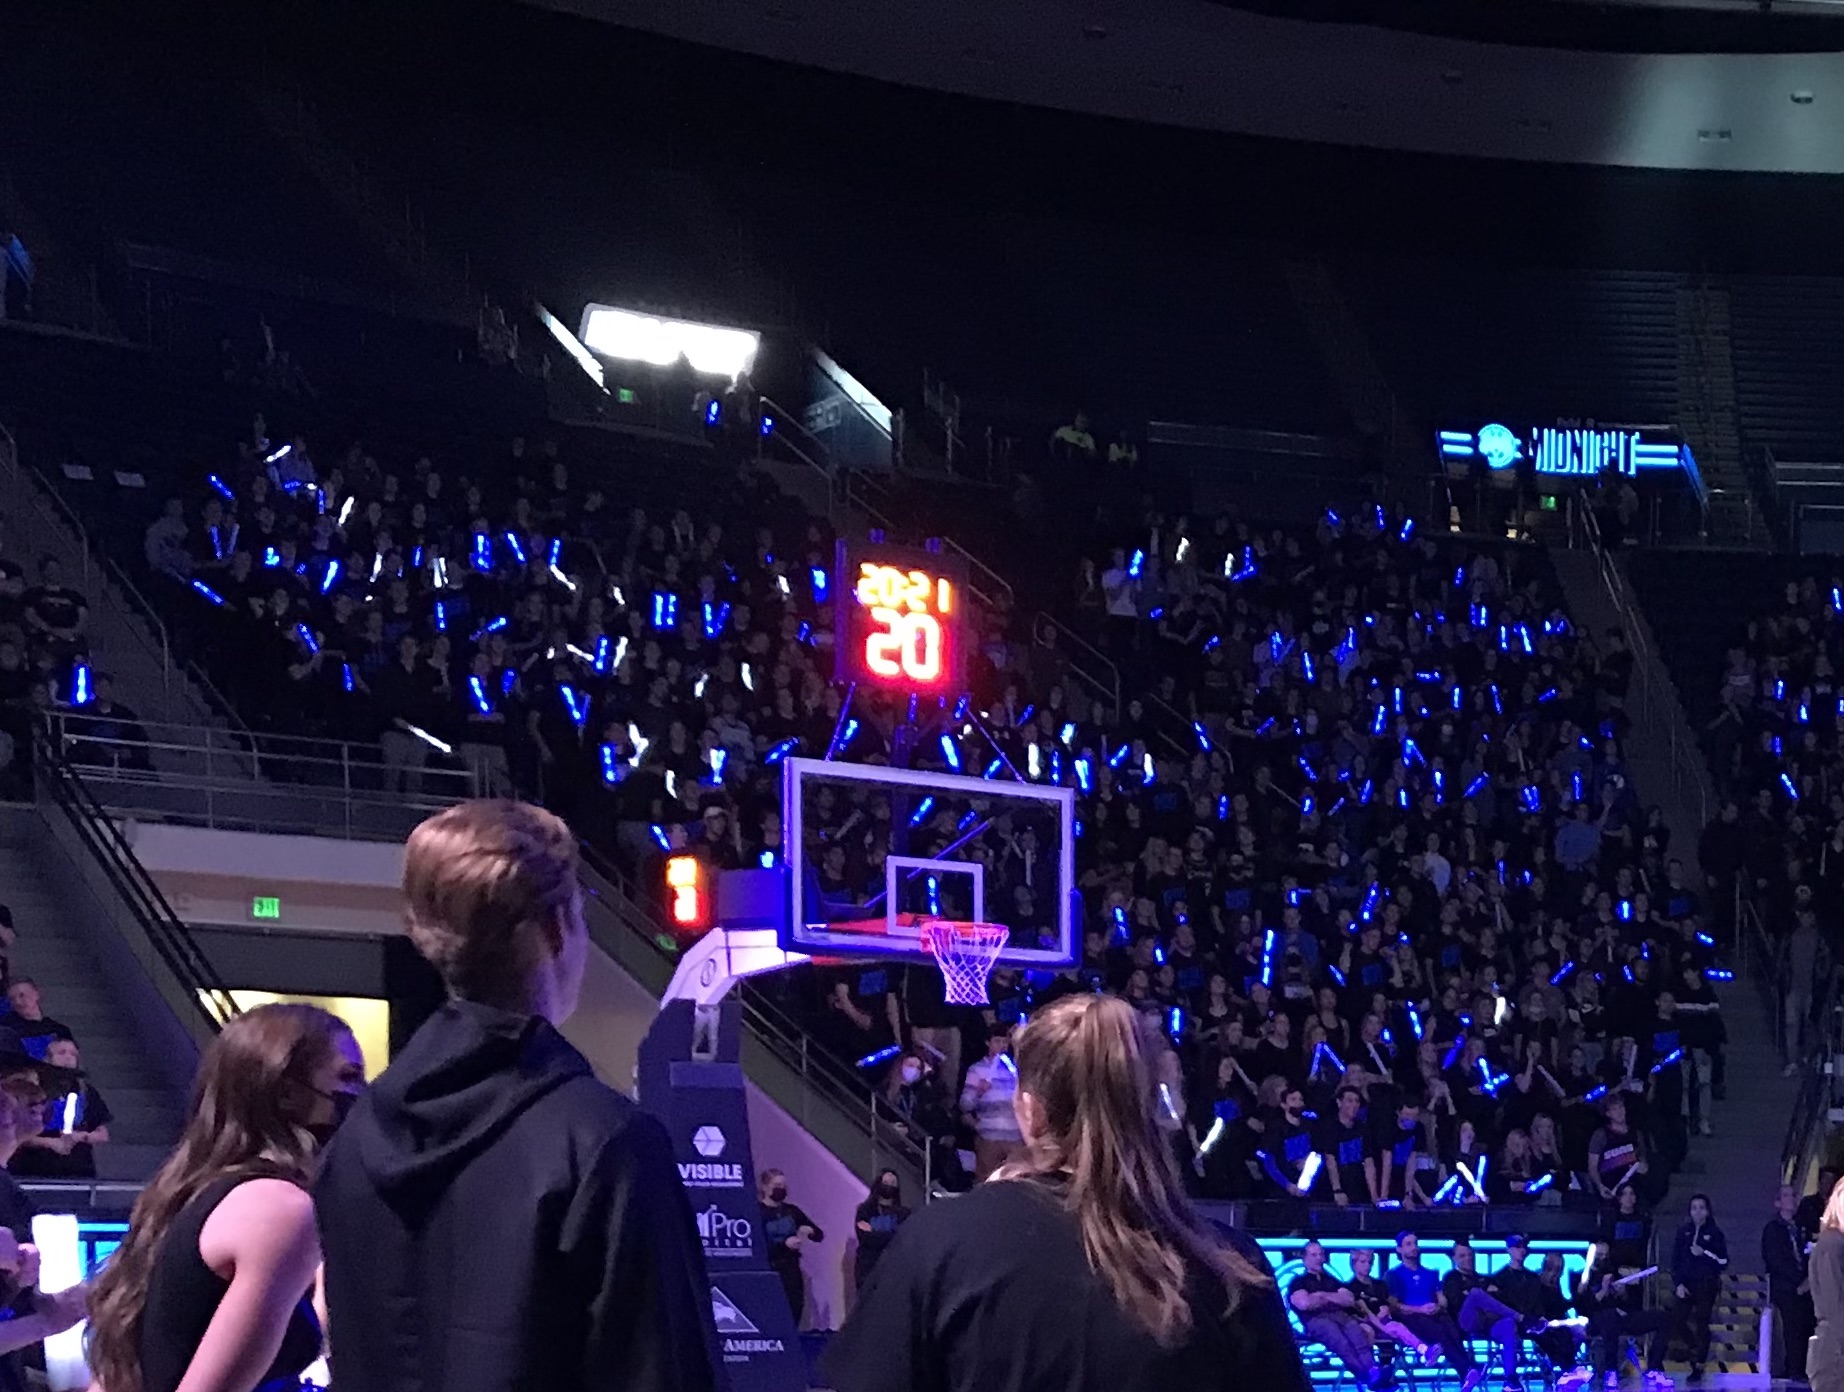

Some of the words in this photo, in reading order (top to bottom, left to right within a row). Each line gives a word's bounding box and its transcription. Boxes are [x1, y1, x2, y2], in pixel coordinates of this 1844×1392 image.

[865, 606, 940, 681] 20
[676, 1163, 743, 1180] VISIBLE
[723, 1338, 784, 1352] AMERICA
